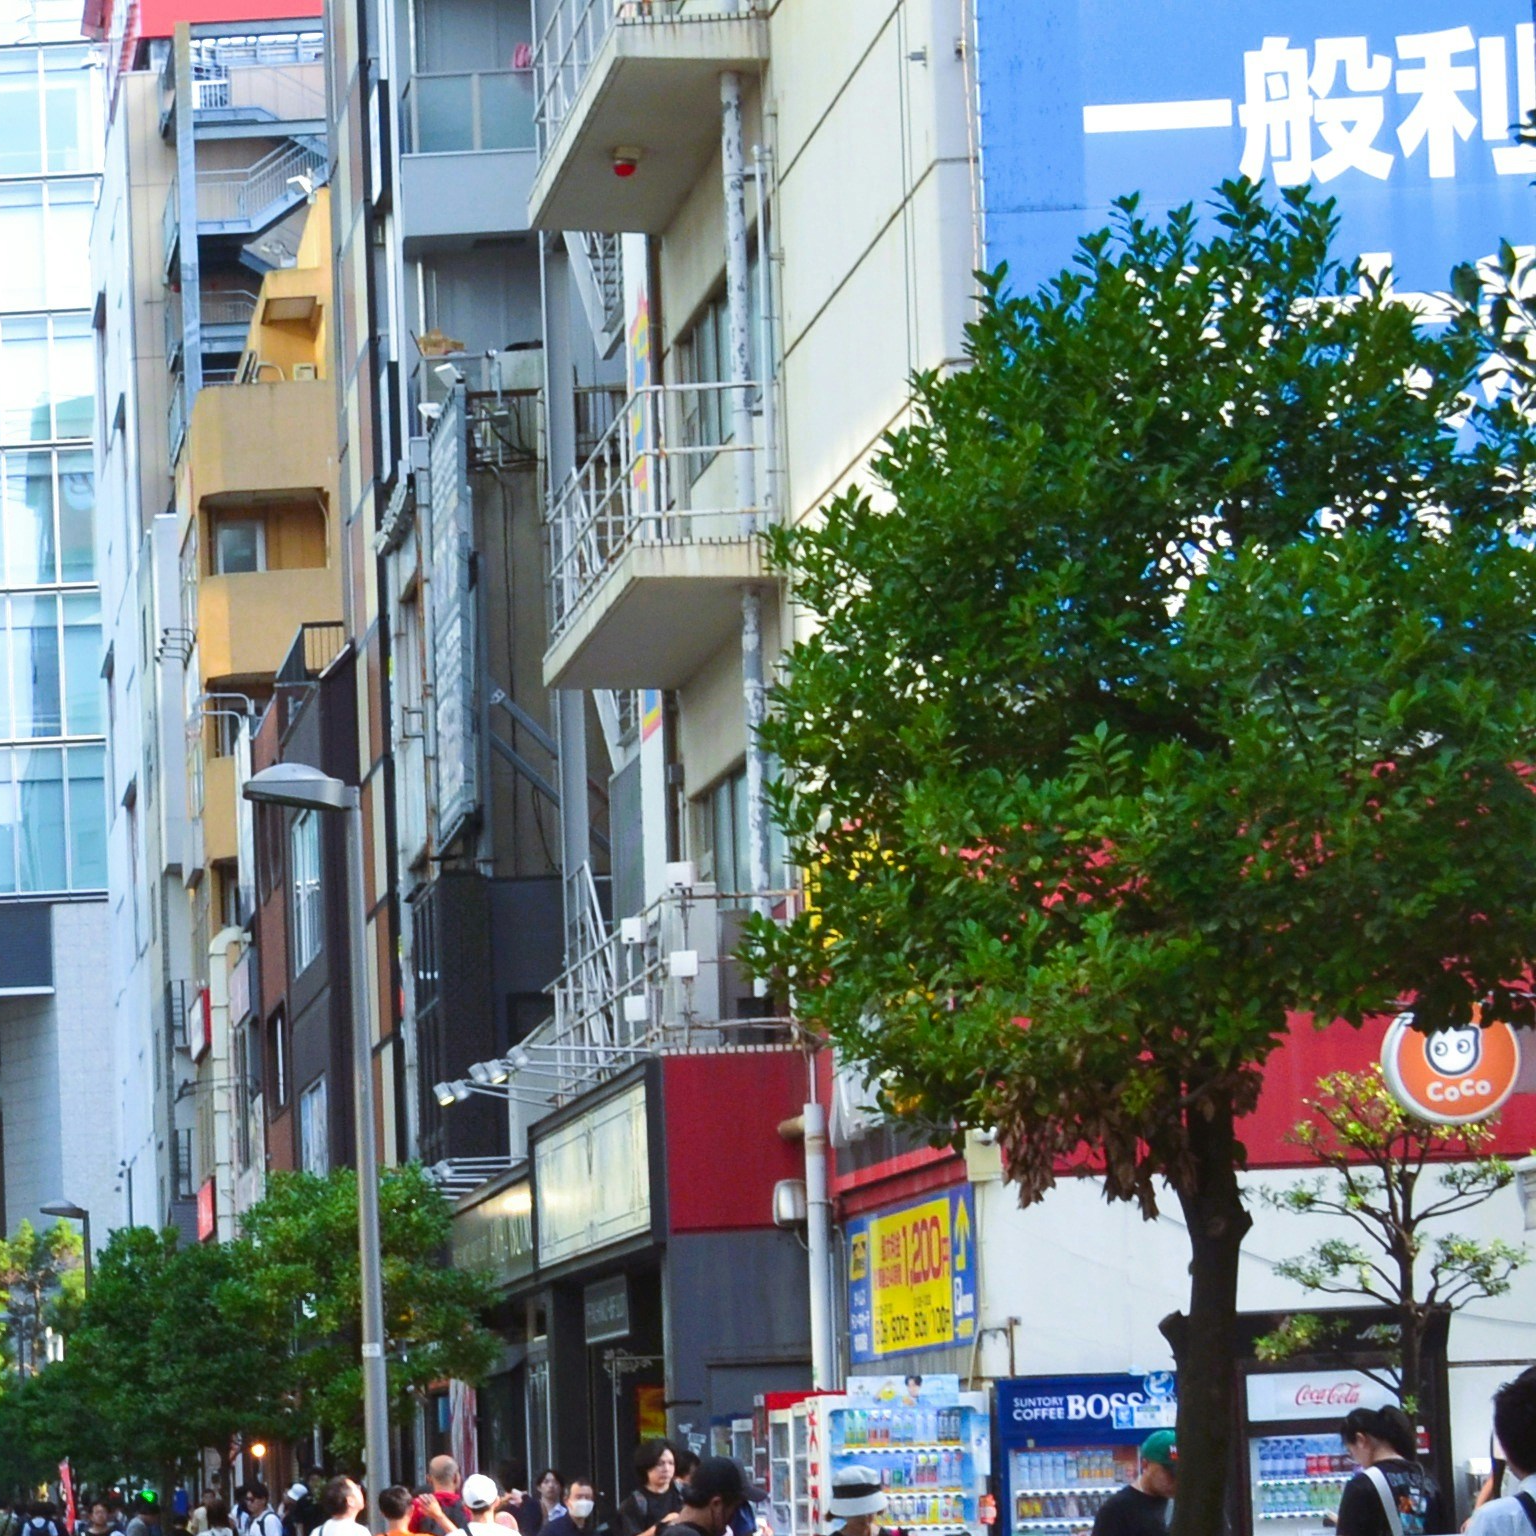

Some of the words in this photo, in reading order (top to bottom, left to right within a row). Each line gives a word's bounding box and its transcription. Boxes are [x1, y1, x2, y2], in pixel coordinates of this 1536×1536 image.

[1426, 1078, 1491, 1102] CoCo
[1013, 1396, 1064, 1408] SUNTORY
[1013, 1407, 1065, 1421] COFFEE
